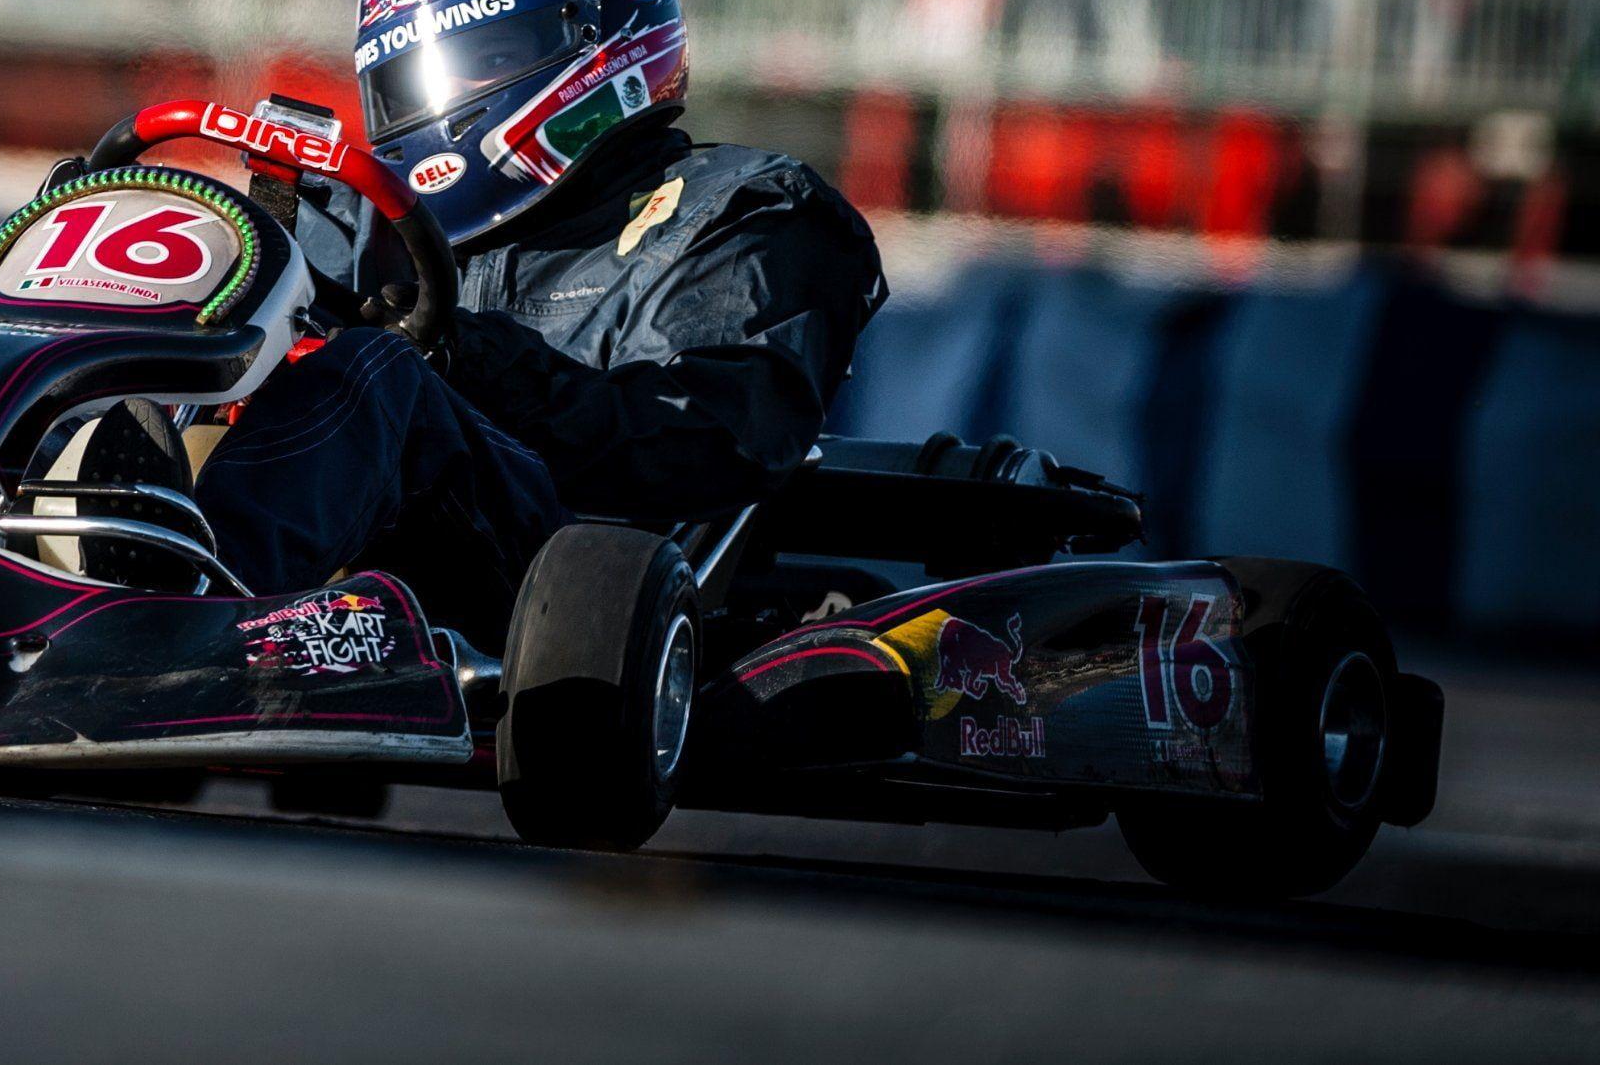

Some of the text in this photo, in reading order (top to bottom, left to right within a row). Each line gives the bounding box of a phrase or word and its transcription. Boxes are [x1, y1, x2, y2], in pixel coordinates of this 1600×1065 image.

[379, 19, 423, 54] YOU
[558, 80, 583, 103] PABLO
[629, 44, 648, 65] INDA
[199, 101, 351, 173] birel
[415, 160, 458, 186] BELL
[25, 200, 224, 285] 16
[130, 286, 160, 302] INDA
[315, 612, 386, 638] KART
[306, 636, 382, 666] FIGHT
[1134, 591, 1236, 733] 16
